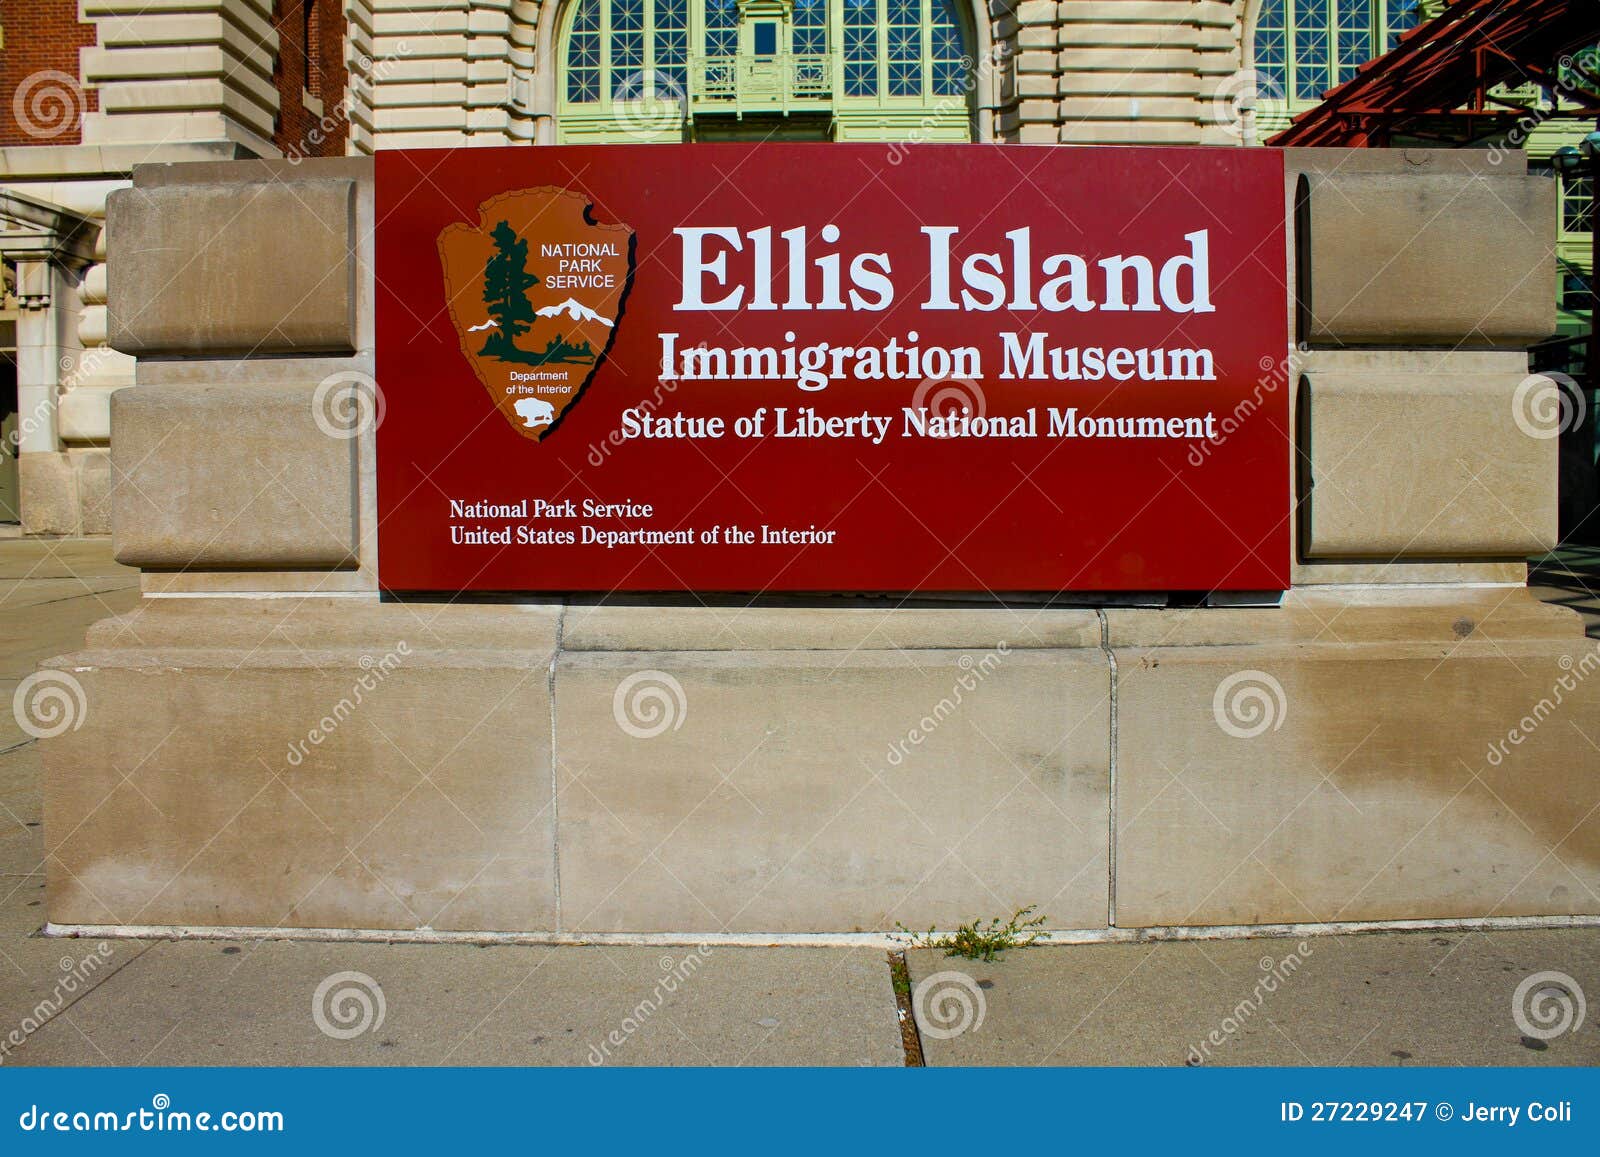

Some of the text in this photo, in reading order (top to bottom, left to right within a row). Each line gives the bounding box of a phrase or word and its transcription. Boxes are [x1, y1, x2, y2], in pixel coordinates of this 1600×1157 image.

[541, 243, 620, 257] NATIONAL
[559, 258, 602, 273] PARK
[673, 225, 1216, 313] Ellis Island
[545, 274, 615, 289] SERVICE
[657, 331, 1217, 391] Immigration Museum
[510, 371, 568, 383] Department
[506, 384, 572, 394] of the Interior
[621, 407, 1217, 445] Statue of Liberty National Monument
[449, 498, 653, 518] National Park Service
[450, 525, 836, 549] United States Department of the Interior
